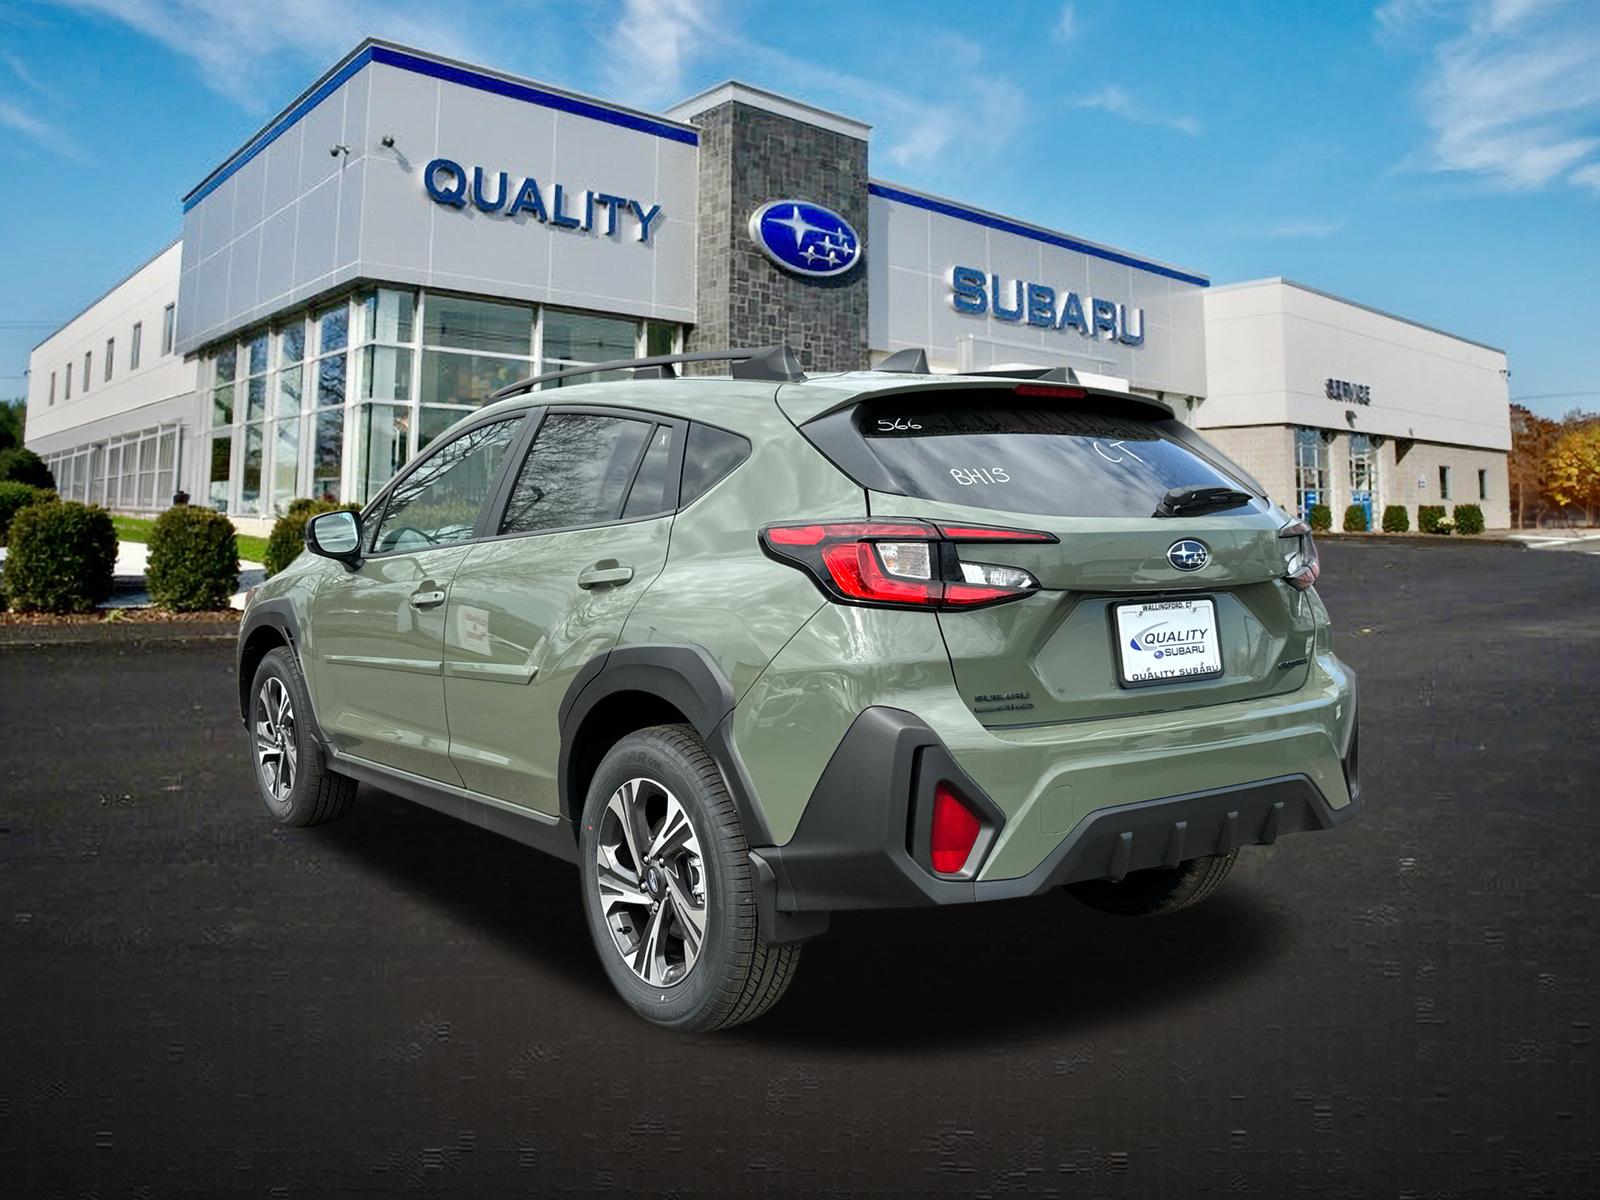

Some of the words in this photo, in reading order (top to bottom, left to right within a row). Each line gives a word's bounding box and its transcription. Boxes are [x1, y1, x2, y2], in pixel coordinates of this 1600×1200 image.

[424, 158, 662, 242] QUALITY
[950, 265, 1145, 347] SUBARU
[877, 418, 923, 431] 566
[1093, 441, 1144, 463] CT
[1144, 628, 1208, 644] QUALITY
[1164, 645, 1205, 657] SUBARU
[1132, 669, 1176, 680] QUALITY
[1178, 665, 1219, 676] SUBARU
